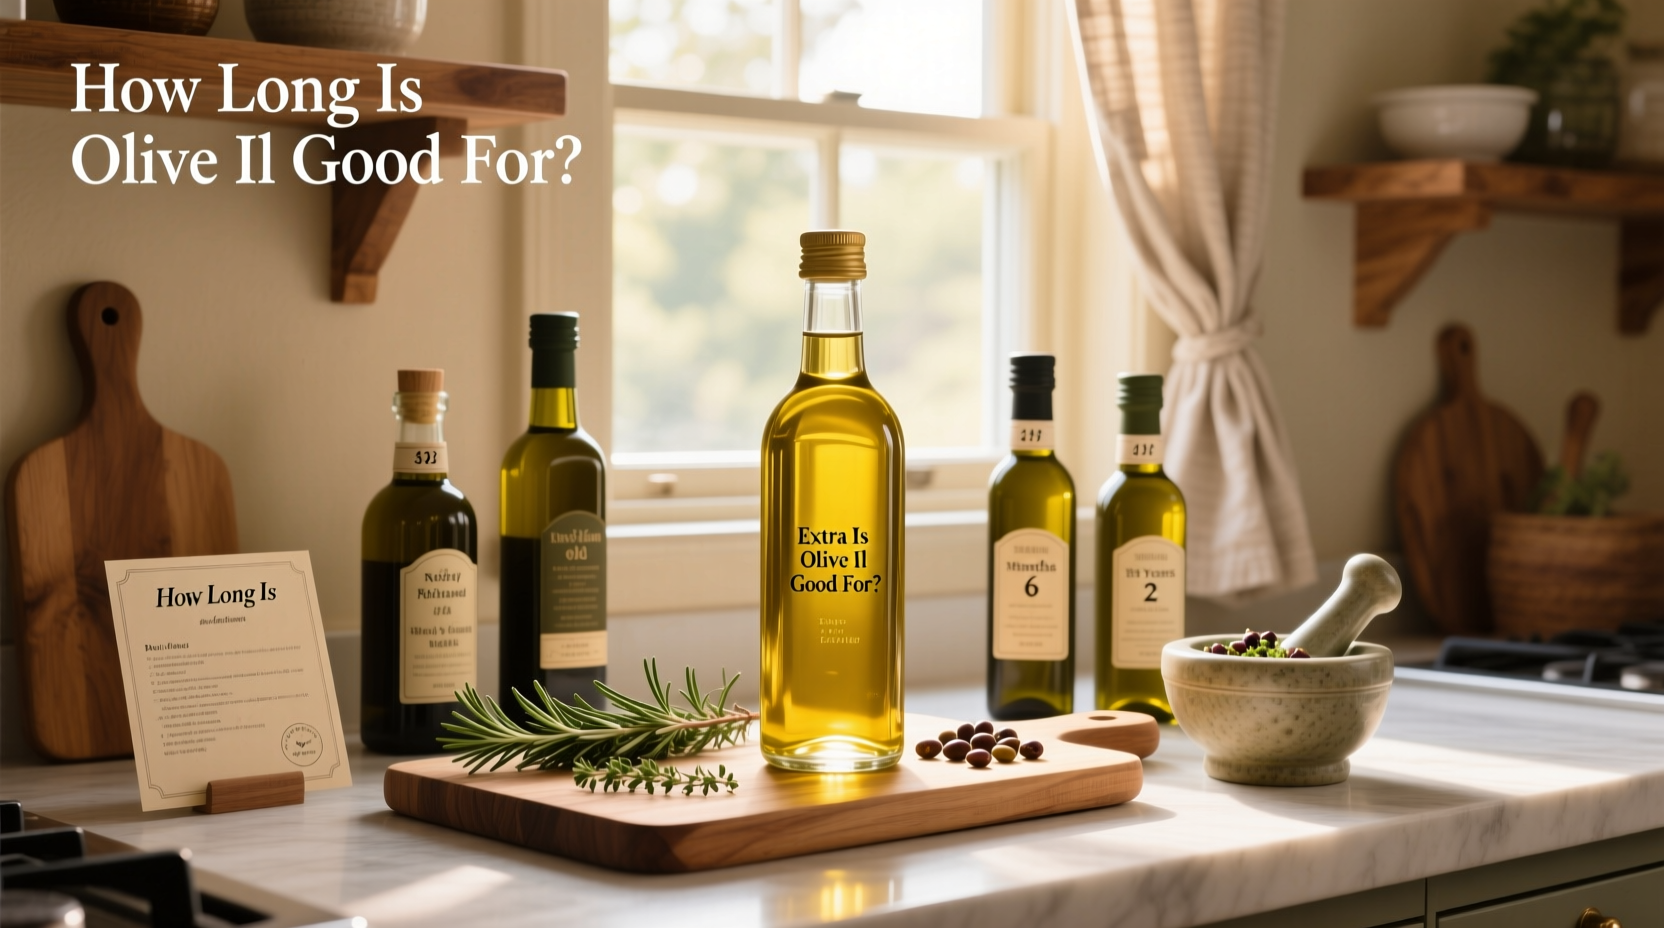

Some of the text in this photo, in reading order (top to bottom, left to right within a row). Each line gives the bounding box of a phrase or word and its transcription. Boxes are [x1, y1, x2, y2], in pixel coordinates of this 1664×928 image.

[797, 526, 869, 545] Extra Is
[800, 550, 849, 569] Olive
[790, 574, 882, 593] Good For?
[1024, 575, 1040, 598] 6
[1143, 581, 1158, 603] 2
[155, 581, 277, 608] How Long Is
